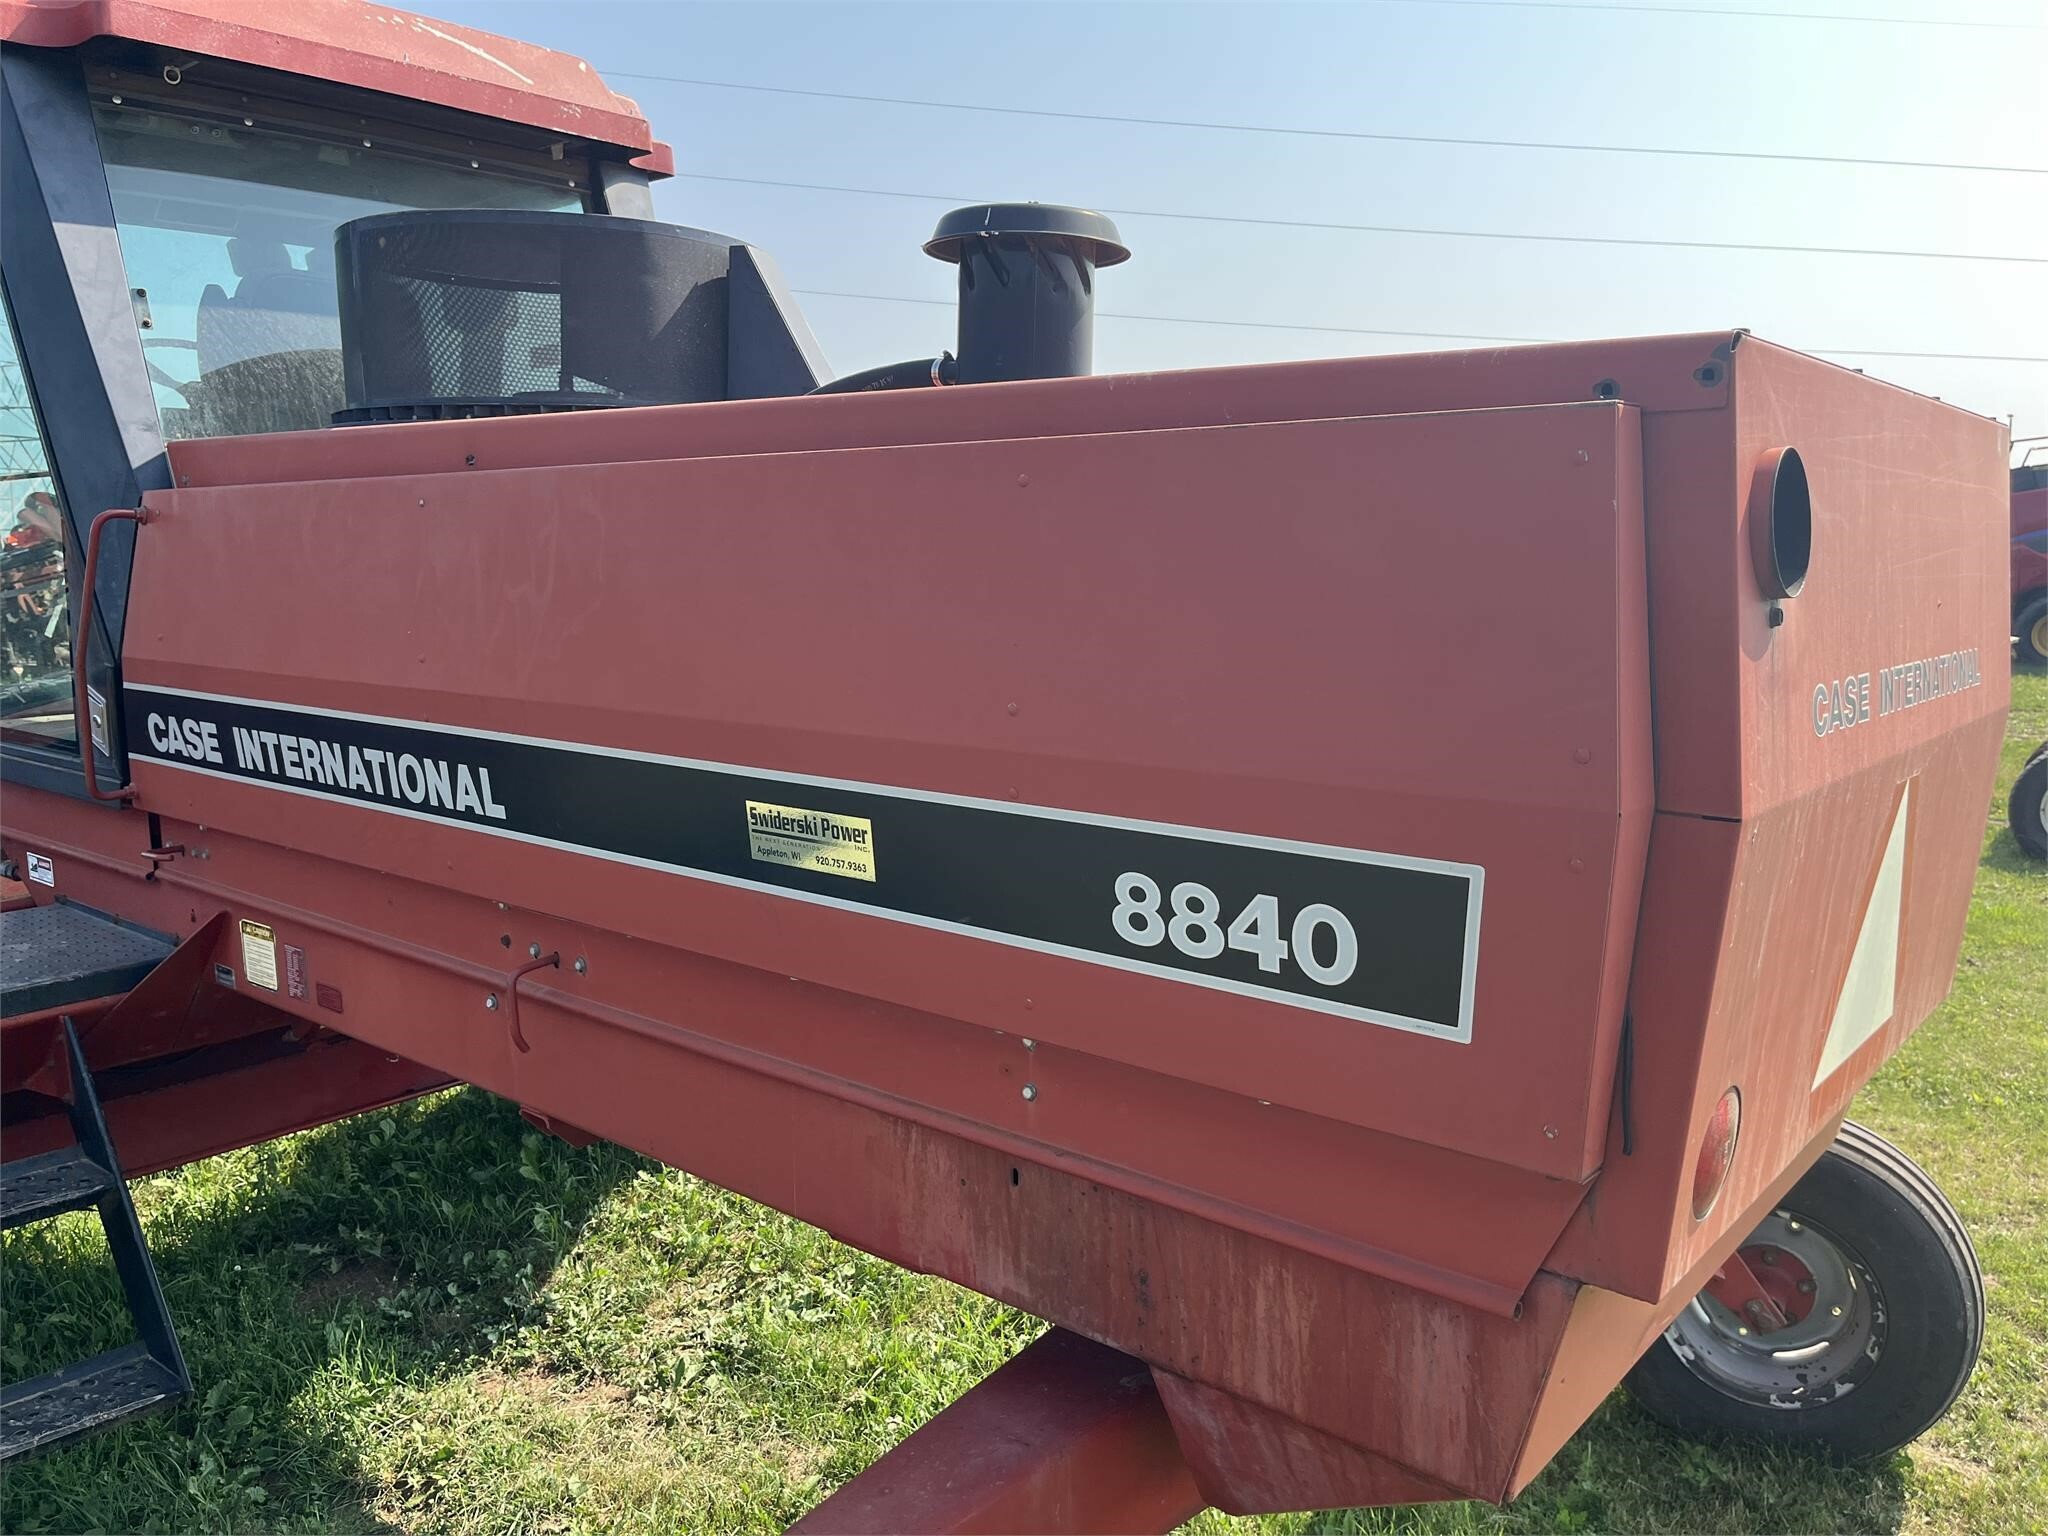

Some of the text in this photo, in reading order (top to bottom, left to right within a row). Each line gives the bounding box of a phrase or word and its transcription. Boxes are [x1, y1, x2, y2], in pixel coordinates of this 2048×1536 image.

[1812, 647, 1981, 738] CASE INTERNATIONAL
[147, 712, 506, 820] CASE INTERNATIONAL
[749, 806, 868, 845] Swiderski Power
[757, 845, 790, 860] Appleton,
[815, 855, 867, 873] 920.757.9363
[1111, 871, 1358, 986] 8840
